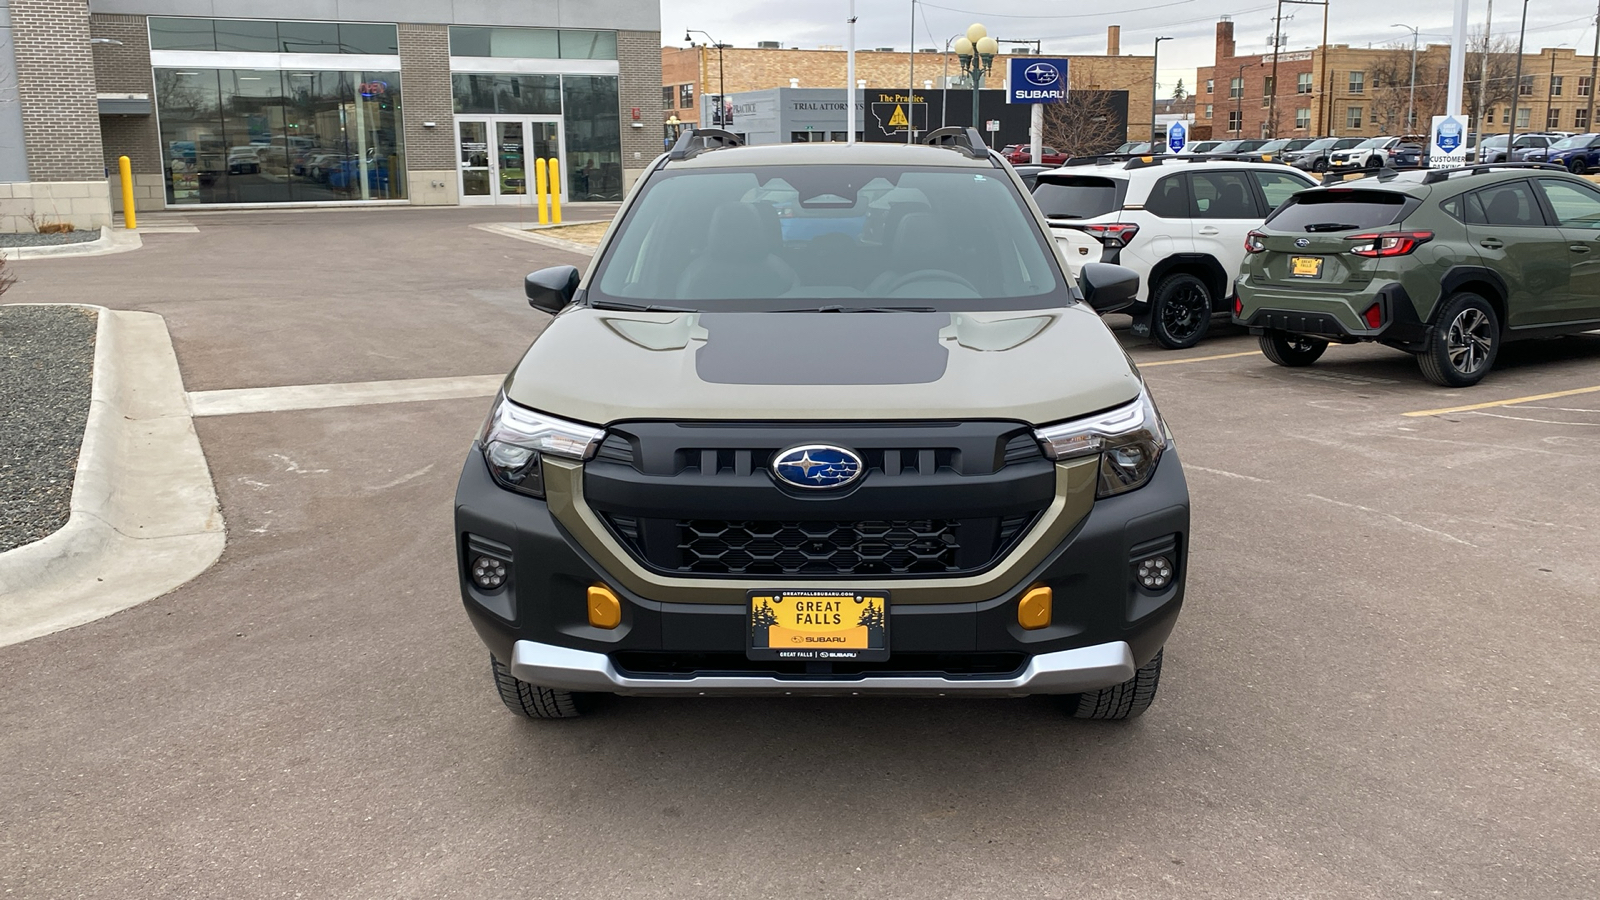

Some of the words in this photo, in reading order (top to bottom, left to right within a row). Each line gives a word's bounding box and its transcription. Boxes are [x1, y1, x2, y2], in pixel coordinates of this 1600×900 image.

[879, 94, 893, 102] The
[1015, 90, 1064, 99] SUBARU
[796, 601, 841, 612] GREAT
[796, 613, 842, 625] FALLS
